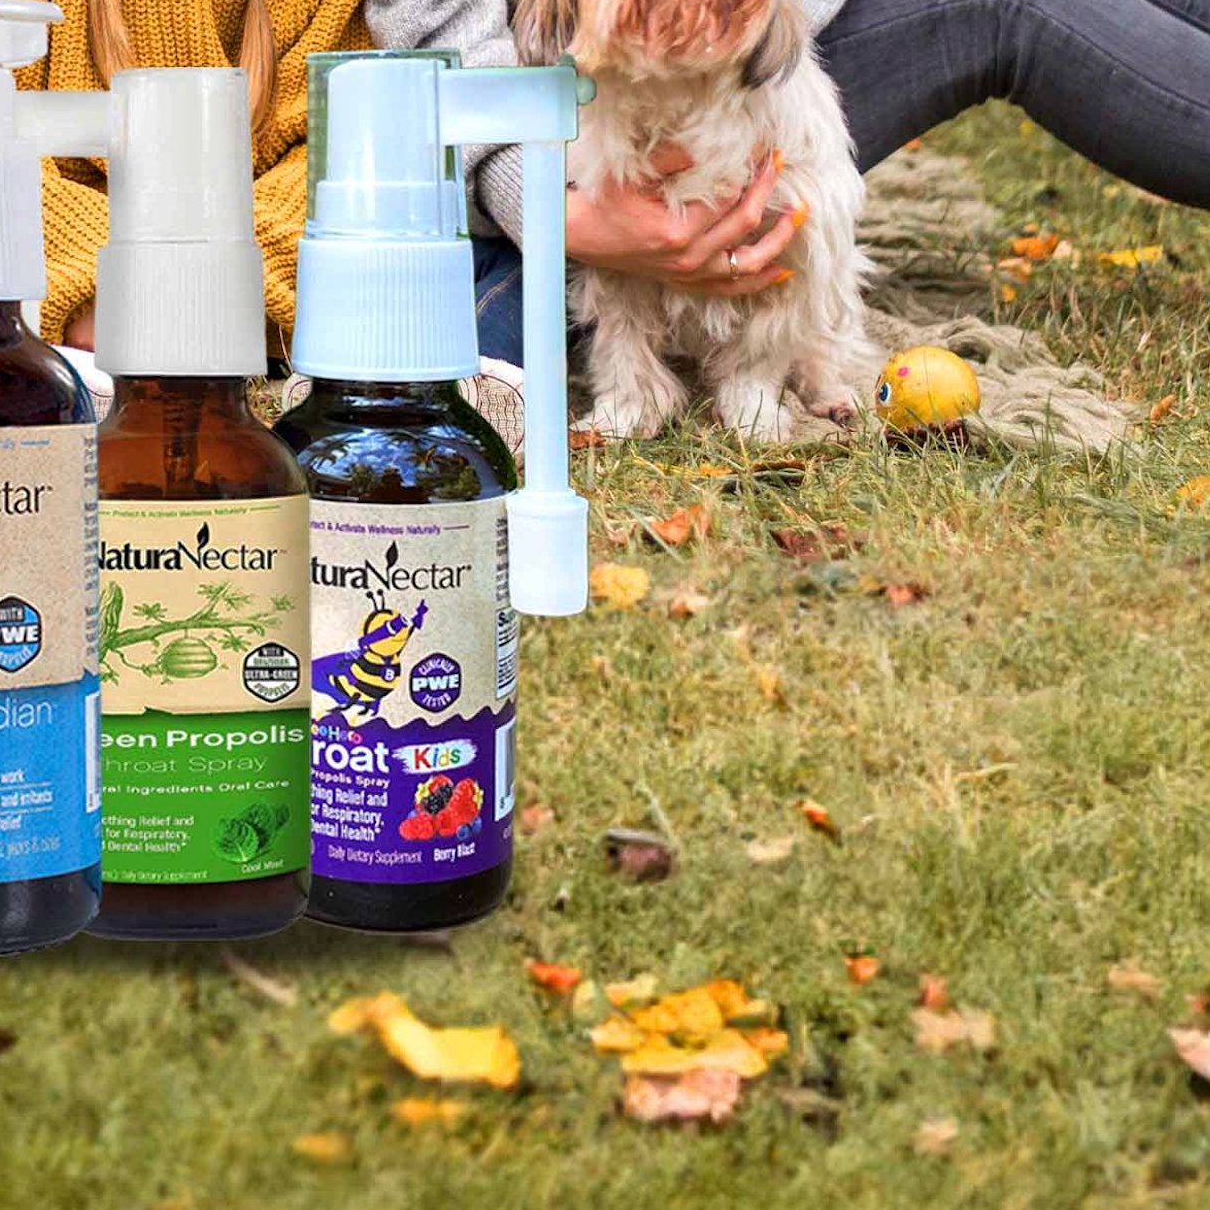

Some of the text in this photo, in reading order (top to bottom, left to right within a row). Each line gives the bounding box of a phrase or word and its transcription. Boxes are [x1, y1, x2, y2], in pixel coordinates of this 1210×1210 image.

[311, 540, 466, 591] turaNectar
[412, 674, 459, 692] PWE
[101, 725, 305, 751] een Propolis
[312, 740, 462, 773] roat Kids
[105, 756, 268, 776] hroat Spray
[1, 769, 25, 784] work
[356, 775, 390, 789] Spray
[126, 785, 214, 796] Ingredients
[218, 781, 250, 791] Oral
[255, 779, 290, 789] Care
[335, 788, 366, 805] Relief
[367, 789, 388, 807] and
[102, 815, 137, 827] othing
[172, 815, 194, 826] and
[108, 841, 142, 852] Dental
[328, 845, 344, 863] Daily
[375, 850, 422, 866] Supplement
[433, 847, 456, 863] Berry
